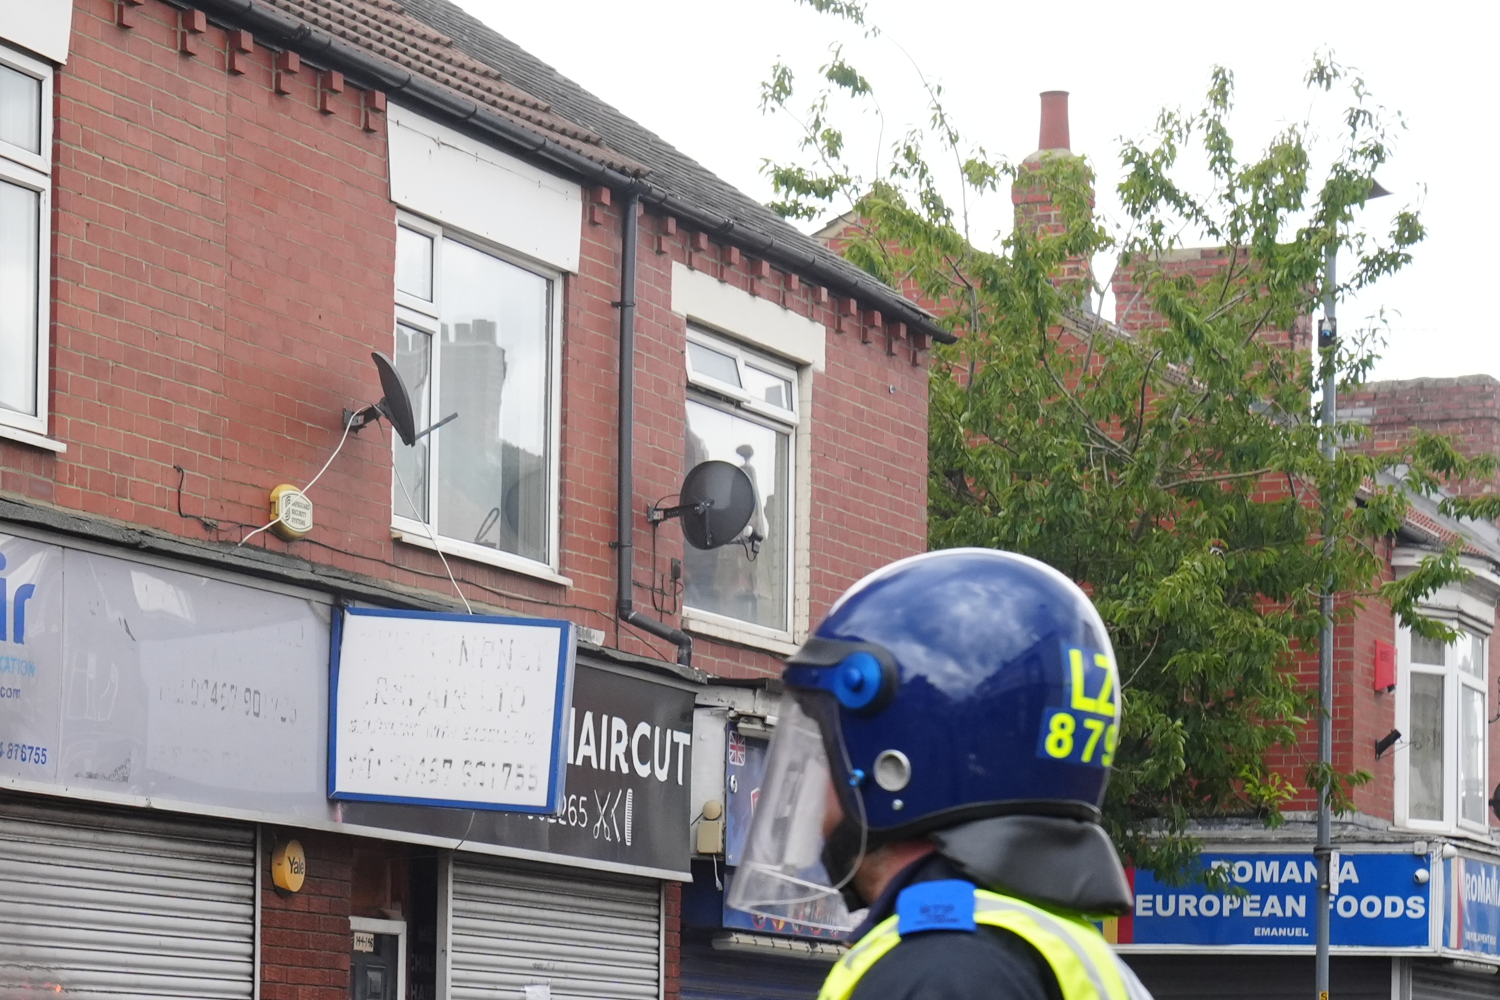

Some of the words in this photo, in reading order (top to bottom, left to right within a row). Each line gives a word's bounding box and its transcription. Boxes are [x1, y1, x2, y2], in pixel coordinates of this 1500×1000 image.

[6, 742, 47, 765] 876755
[287, 856, 305, 875] Yale
[1210, 860, 1359, 883] ROMANA
[1135, 894, 1306, 917] EUROPEAN
[1254, 927, 1309, 937] EMANUEL
